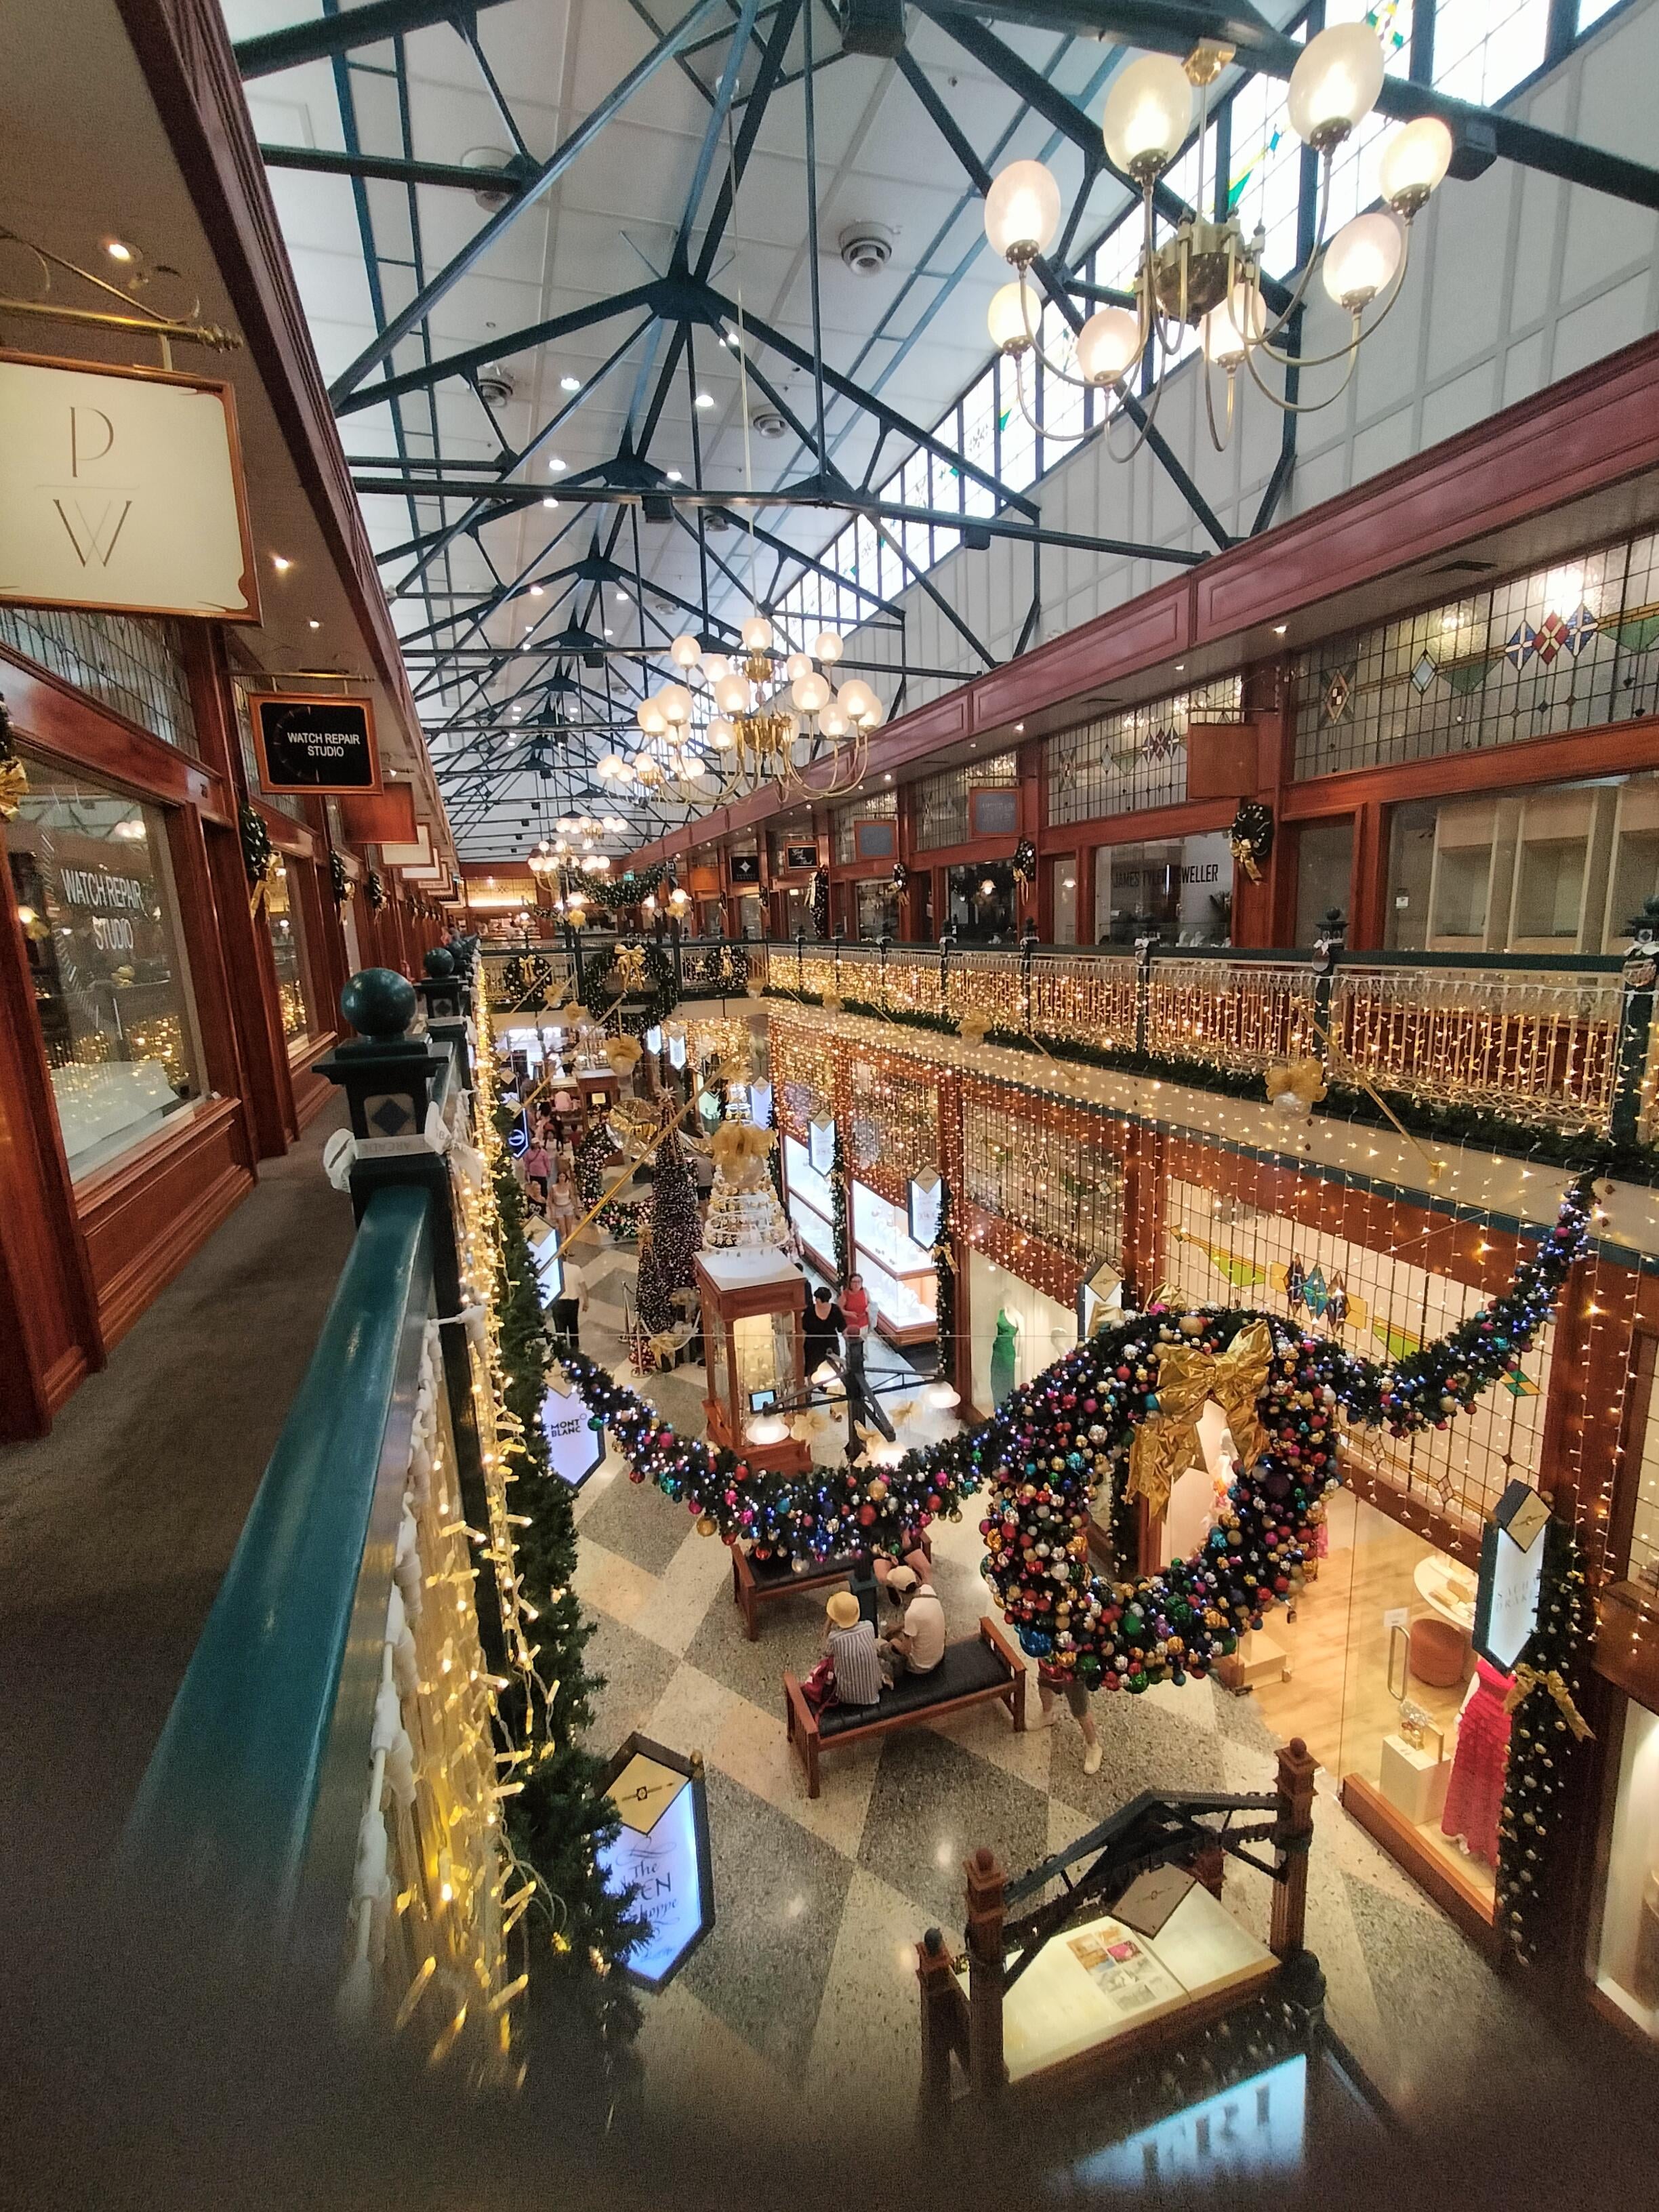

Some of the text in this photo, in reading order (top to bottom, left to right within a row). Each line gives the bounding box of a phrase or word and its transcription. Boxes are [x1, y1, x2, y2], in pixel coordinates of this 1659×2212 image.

[70, 406, 114, 477] P
[53, 498, 132, 568] W
[287, 732, 361, 745] WATCH REPAIR
[307, 745, 344, 757] STUDIO
[1113, 871, 1139, 888] JAMES
[1172, 864, 1218, 884] WELLER
[60, 868, 143, 909] WATCH REPAIR
[92, 916, 134, 950] STUDIO
[551, 1418, 580, 1430] MONT
[551, 1426, 581, 1437] BLANC
[630, 1860, 658, 1879] The
[640, 1872, 672, 1900] EN
[636, 1898, 677, 1922] hoppe
